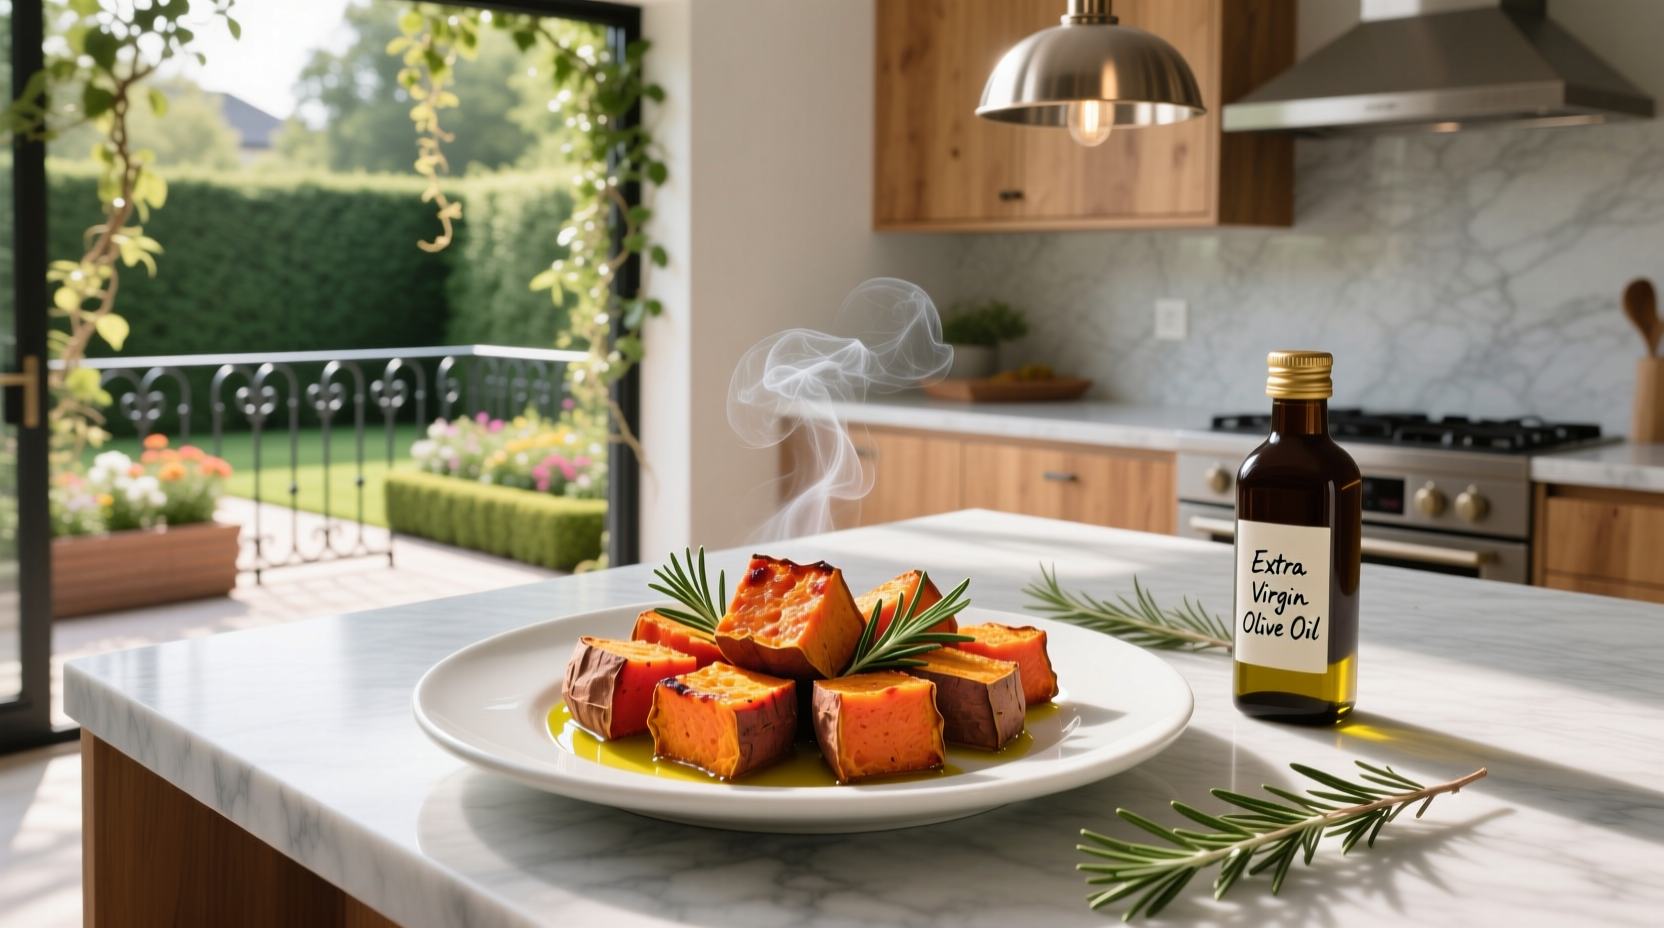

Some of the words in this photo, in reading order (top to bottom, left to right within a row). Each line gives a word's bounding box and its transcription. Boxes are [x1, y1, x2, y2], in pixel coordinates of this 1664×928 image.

[1252, 549, 1307, 576] Extra
[1252, 581, 1309, 615] Virgin
[1243, 611, 1284, 637] Olive
[1290, 616, 1320, 640] Oil
